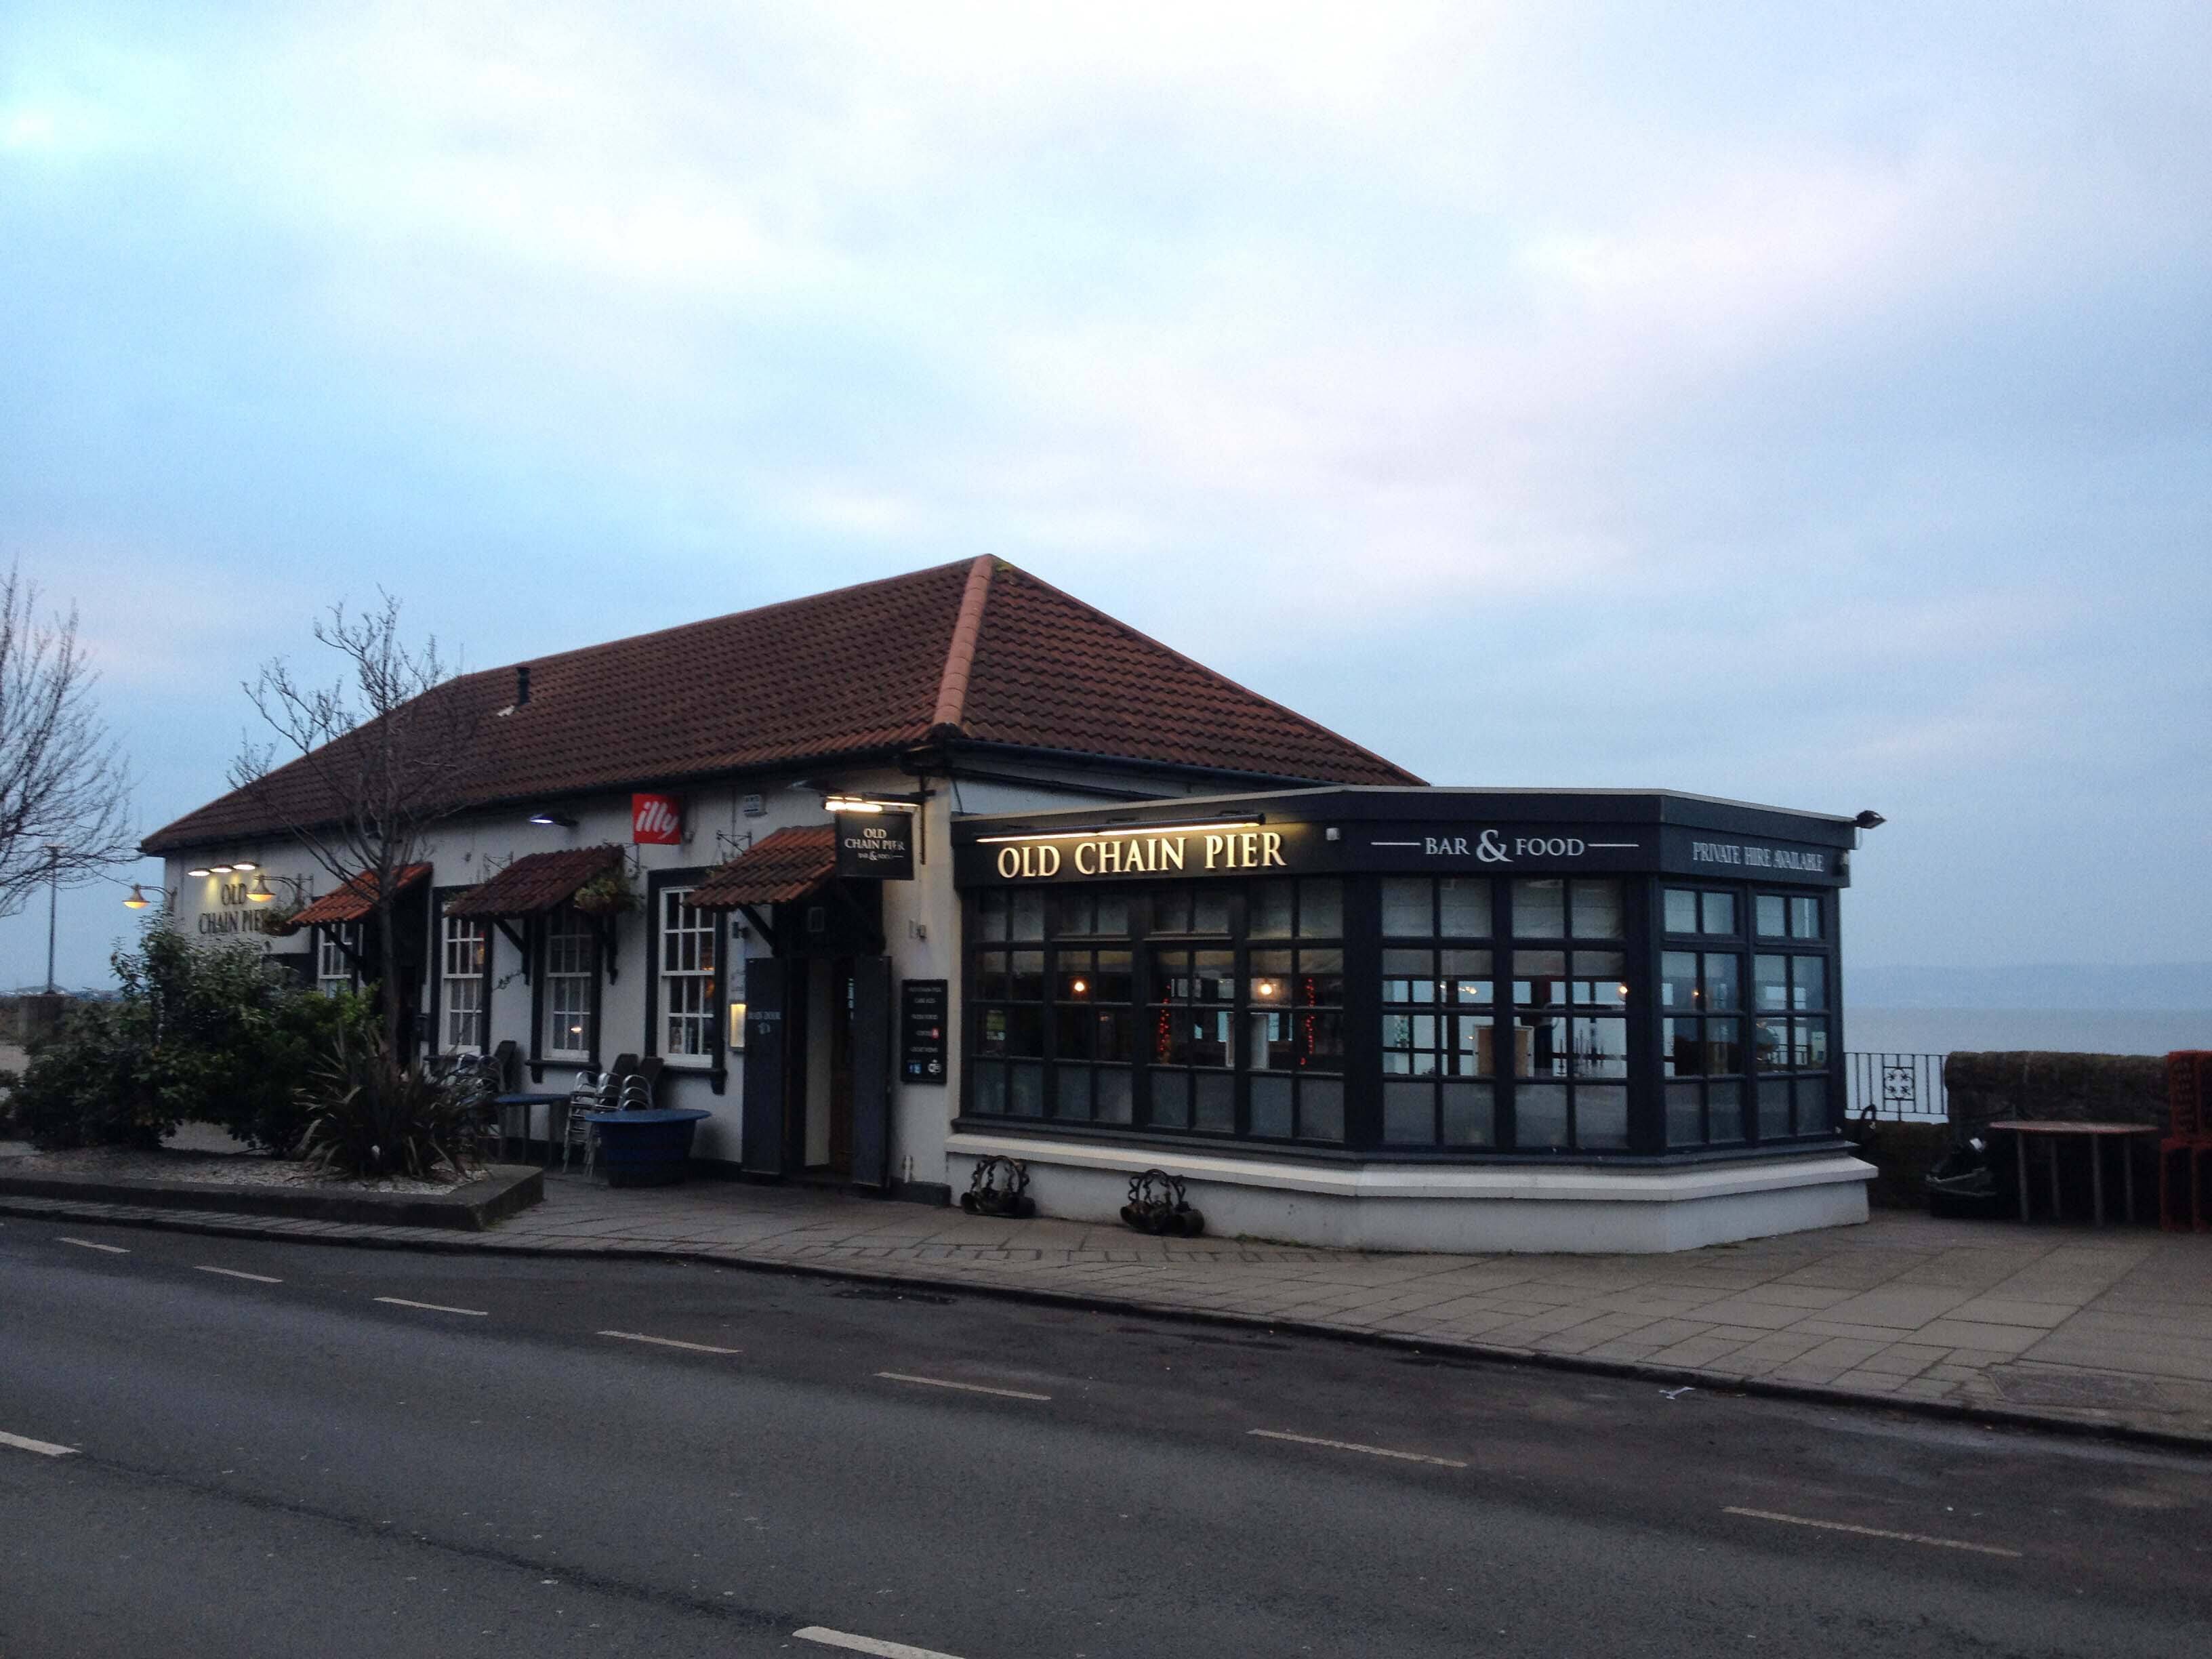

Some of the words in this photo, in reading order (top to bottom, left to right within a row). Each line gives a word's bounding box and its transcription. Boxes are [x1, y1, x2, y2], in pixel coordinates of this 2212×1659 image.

[636, 800, 678, 840] illy
[844, 838, 880, 850] CHAIN
[863, 828, 887, 839] OLD
[1425, 837, 1471, 855] BAR
[1475, 829, 1514, 863] &
[1514, 838, 1585, 856] FOOD
[997, 846, 1061, 878] OLD
[1074, 836, 1188, 875] CHAIN
[1204, 832, 1288, 869] PIER
[1692, 842, 1741, 865] PRIVATE
[1744, 846, 1773, 868] HIRE
[221, 883, 247, 906] OLD
[199, 911, 239, 935] CHAIN
[241, 908, 265, 933] PIE
